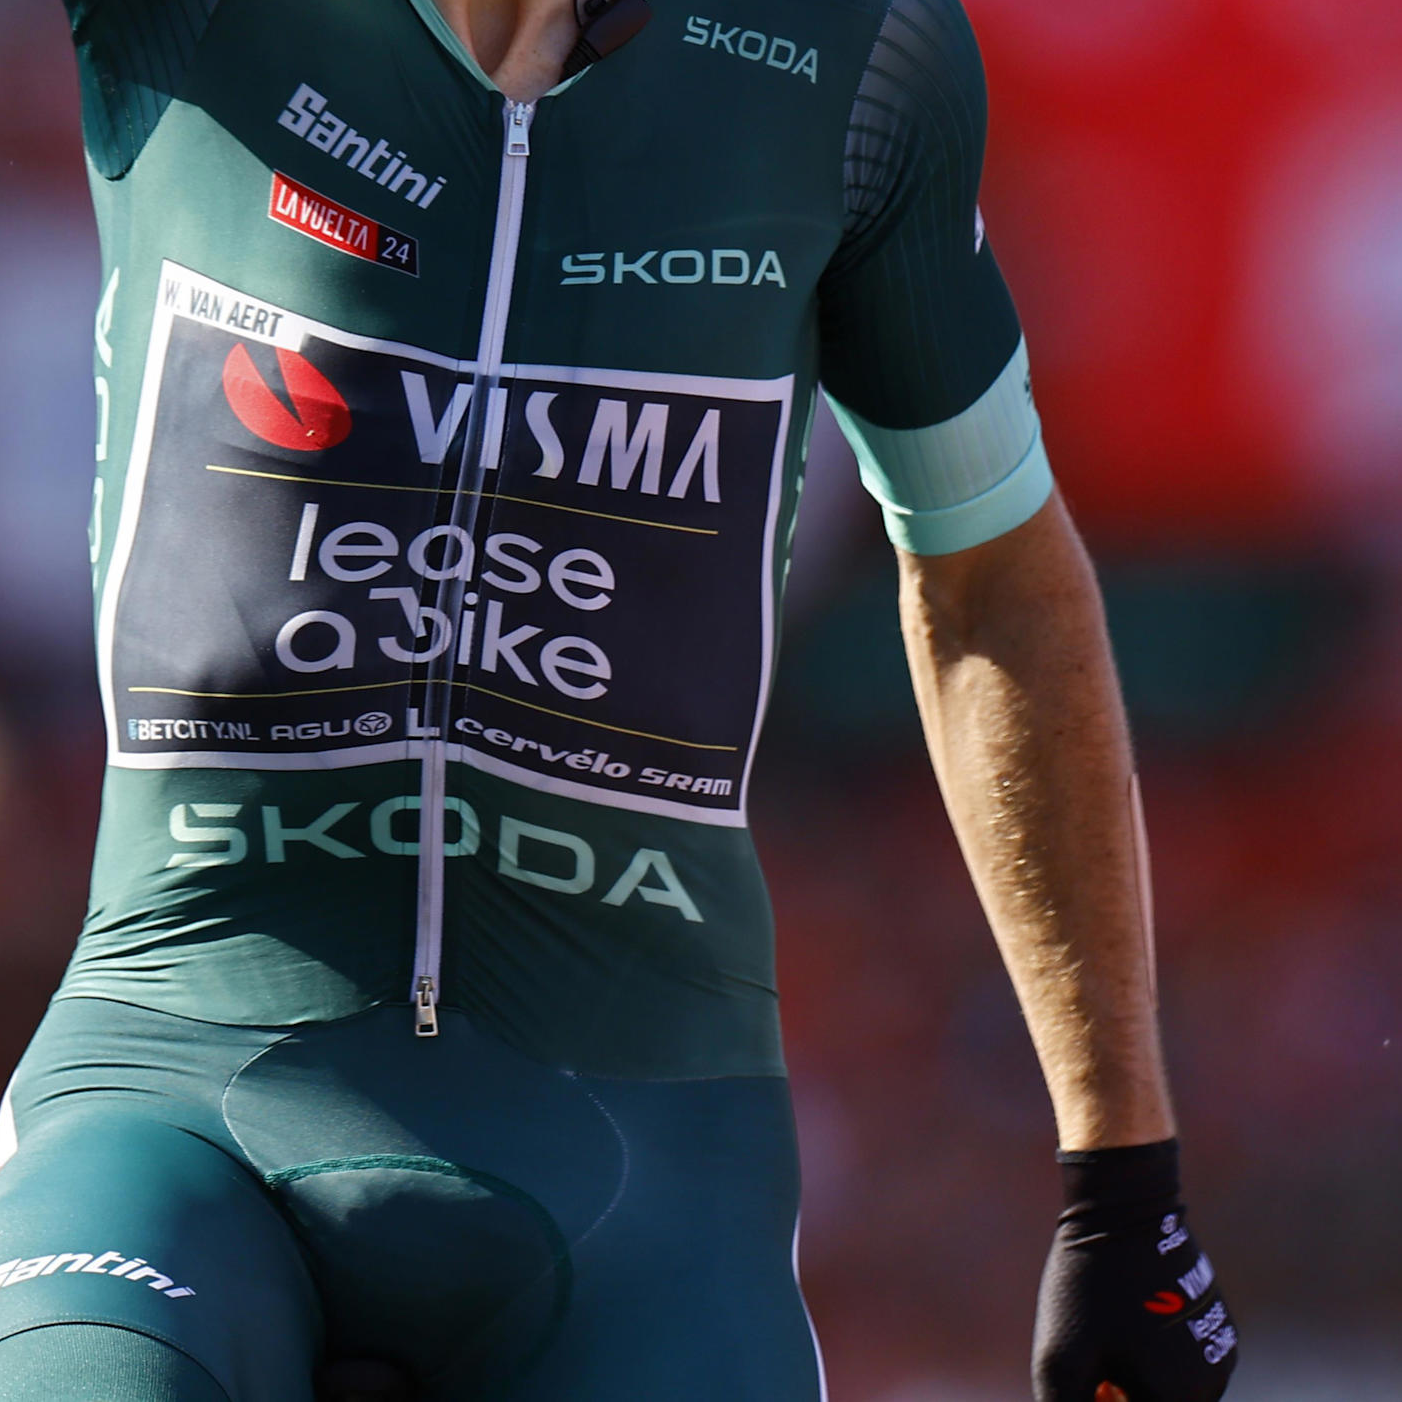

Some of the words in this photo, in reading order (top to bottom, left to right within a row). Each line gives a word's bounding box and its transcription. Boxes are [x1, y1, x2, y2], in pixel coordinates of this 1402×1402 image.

[683, 15, 820, 85] SKODA
[277, 82, 448, 211] Santini
[381, 236, 410, 265] 24
[560, 249, 787, 289] SKODA
[190, 285, 225, 323] VAN
[226, 301, 284, 338] AERT
[400, 369, 722, 504] VISMA
[289, 502, 616, 612] lease
[137, 717, 261, 742] BETCITY.NL
[270, 717, 351, 741] AGU
[454, 717, 632, 779] cervélo
[638, 767, 733, 796] SRAM
[168, 795, 706, 923] SKODA
